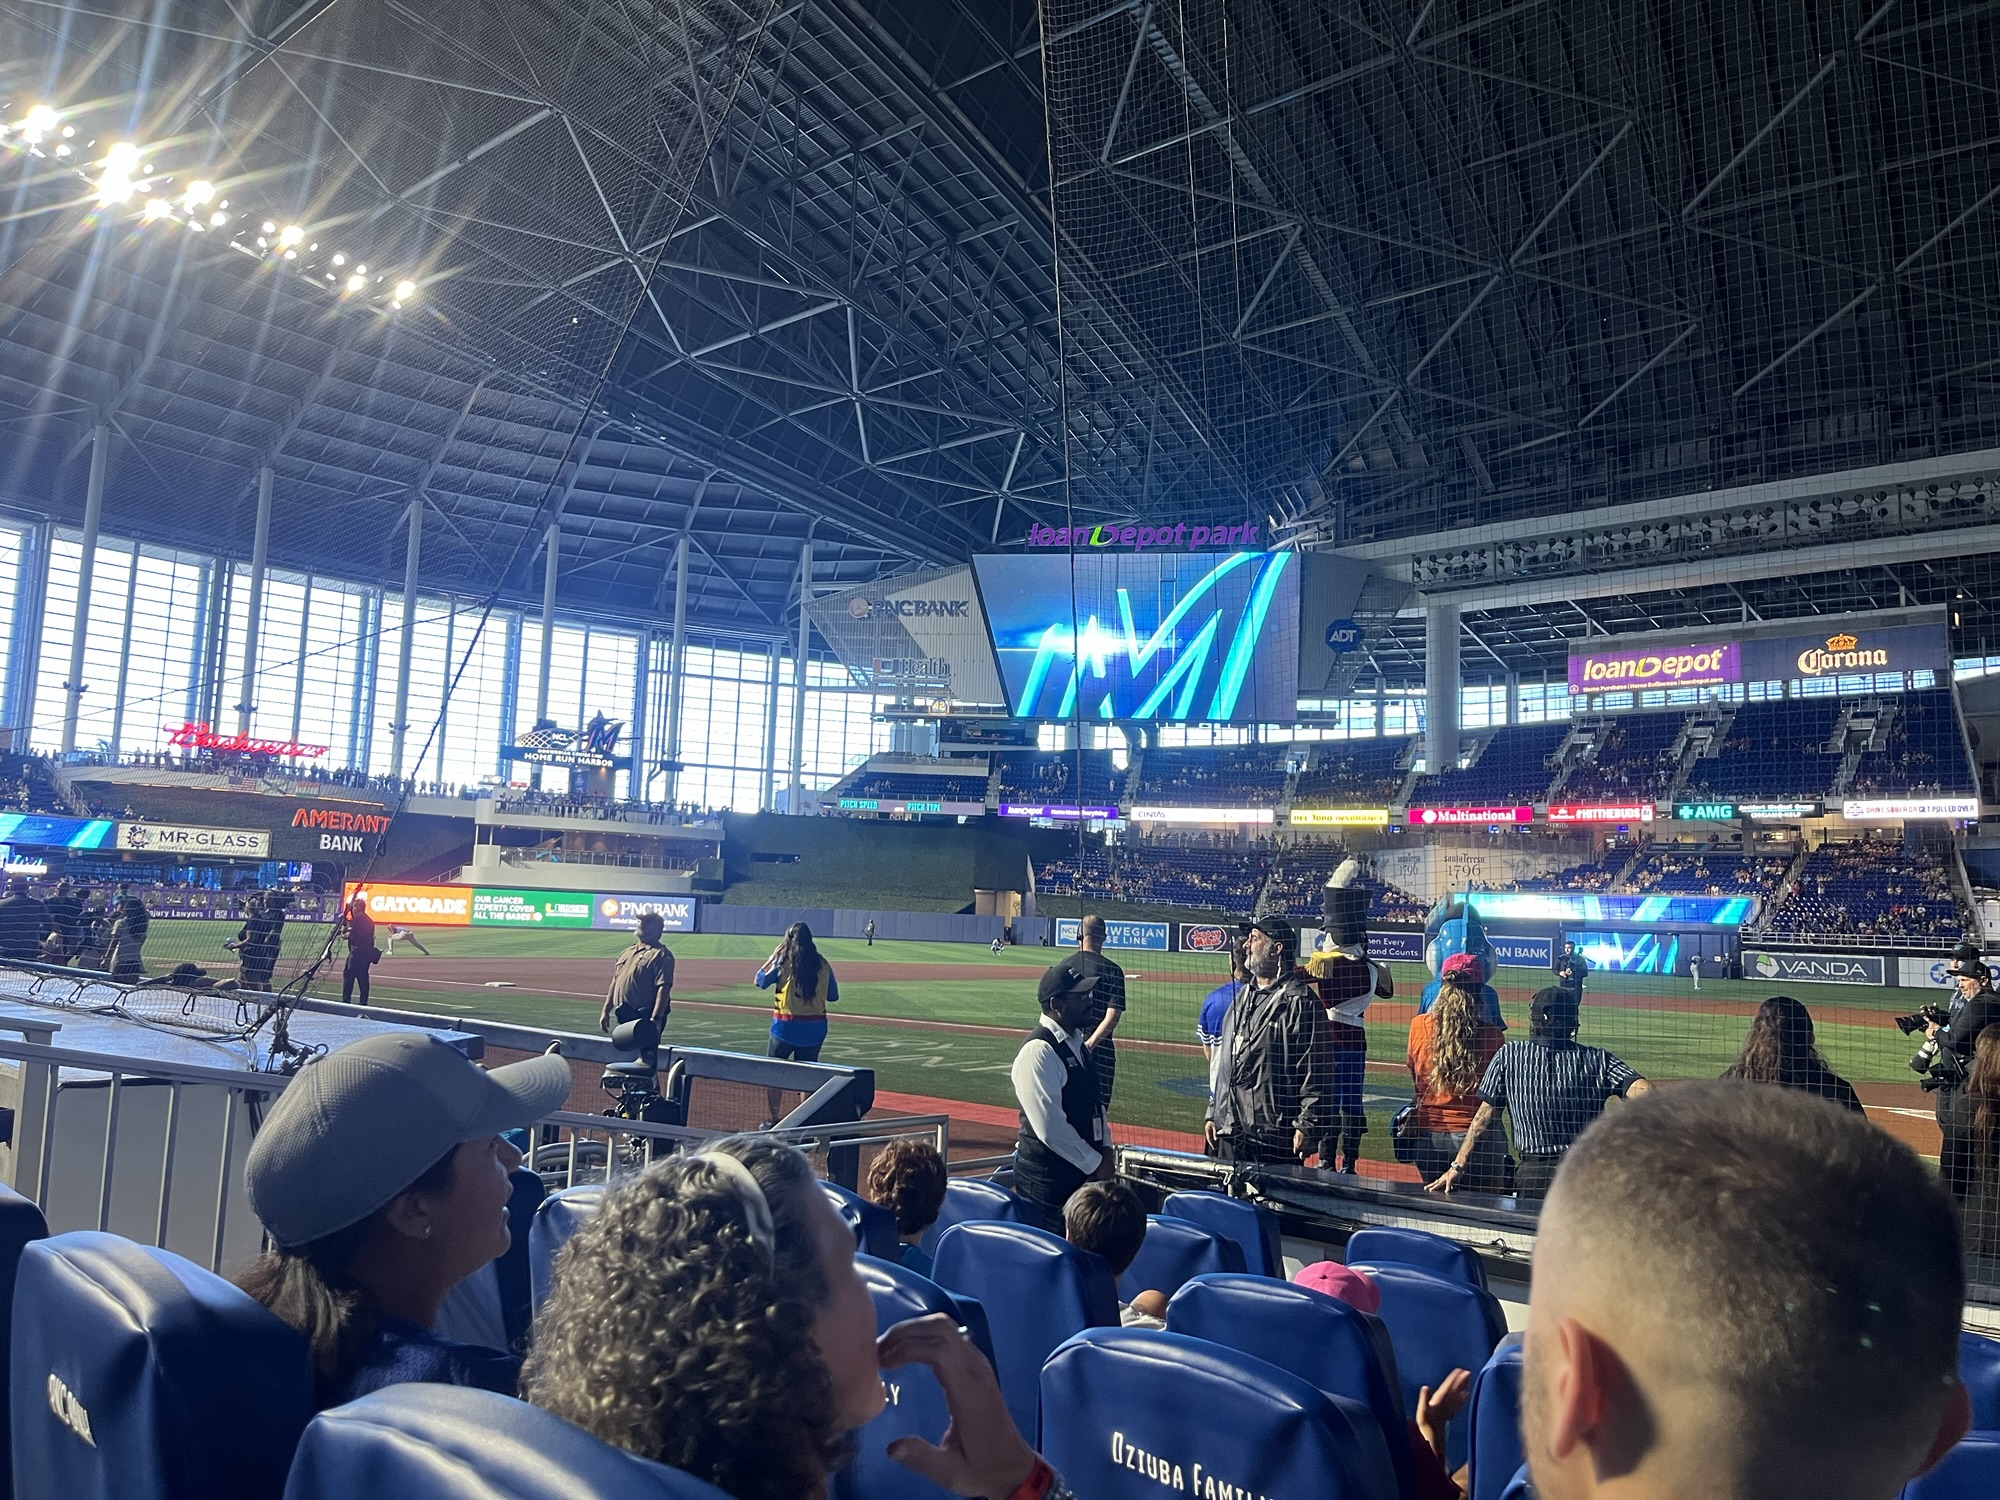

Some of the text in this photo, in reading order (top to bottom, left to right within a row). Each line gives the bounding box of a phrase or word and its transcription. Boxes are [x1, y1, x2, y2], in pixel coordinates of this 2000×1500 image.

[1028, 521, 1261, 552] loanDepot park
[1329, 630, 1357, 643] ADT
[1583, 648, 1723, 681] loanDepot
[1798, 648, 1888, 676] Corona
[163, 722, 331, 758] Budweiser
[552, 732, 569, 741] NCL
[524, 752, 614, 768] HOME RUN HARBOR
[840, 799, 878, 810] PITCH SPEED
[907, 802, 941, 812] PITCH TYPE
[1694, 804, 1733, 819] AMG
[291, 808, 391, 834] AMERANT
[1138, 811, 1166, 819] CINTAS
[1437, 809, 1516, 822] Multinational
[160, 830, 260, 848] MR-GLASS
[320, 834, 364, 852] BANK
[1448, 865, 1481, 880] 1796
[370, 896, 468, 915] GATORADE
[474, 895, 524, 905] OUR CANCER
[474, 904, 535, 913] EXPERTS COVER
[489, 912, 505, 920] THE
[1123, 937, 1148, 945] LINE
[1383, 938, 1406, 948] Every
[1514, 947, 1549, 959] BANK
[1781, 959, 1868, 977] VANDA
